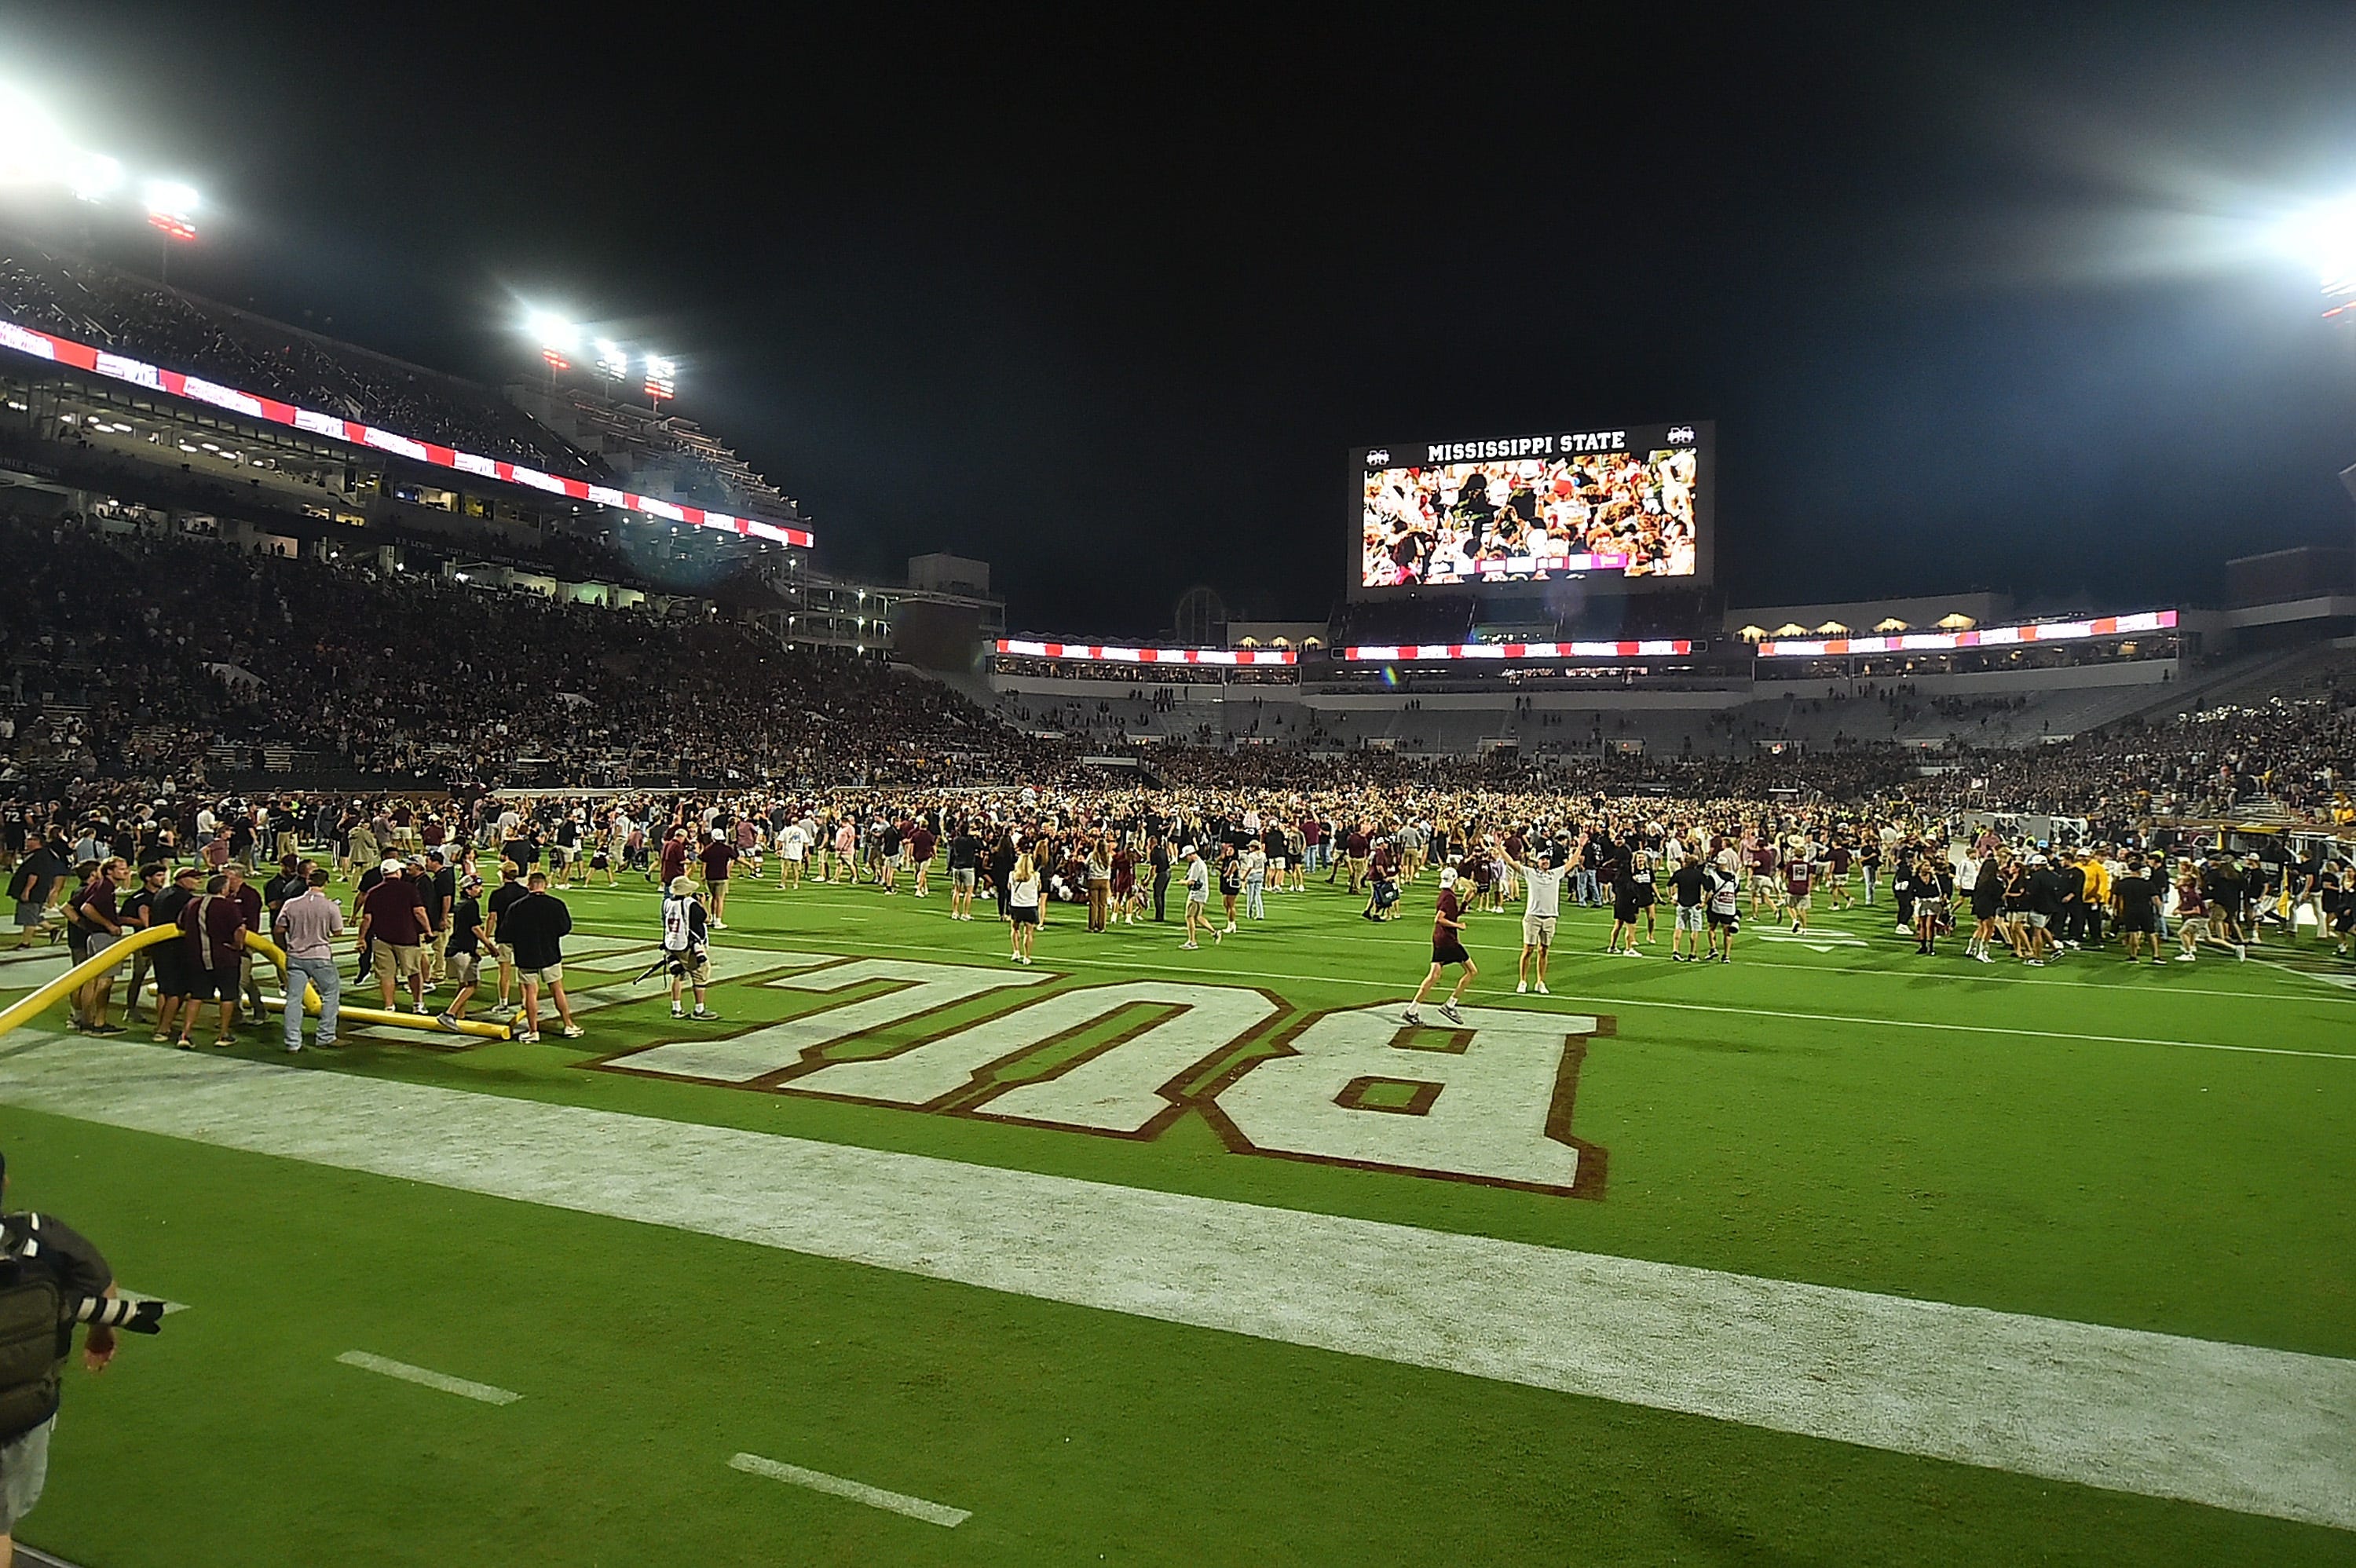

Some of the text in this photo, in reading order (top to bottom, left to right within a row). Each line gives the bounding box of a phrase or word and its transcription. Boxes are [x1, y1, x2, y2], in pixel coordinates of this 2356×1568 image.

[1428, 431, 1625, 462] MISSISSIPPI STATE
[5, 811, 21, 822] 72
